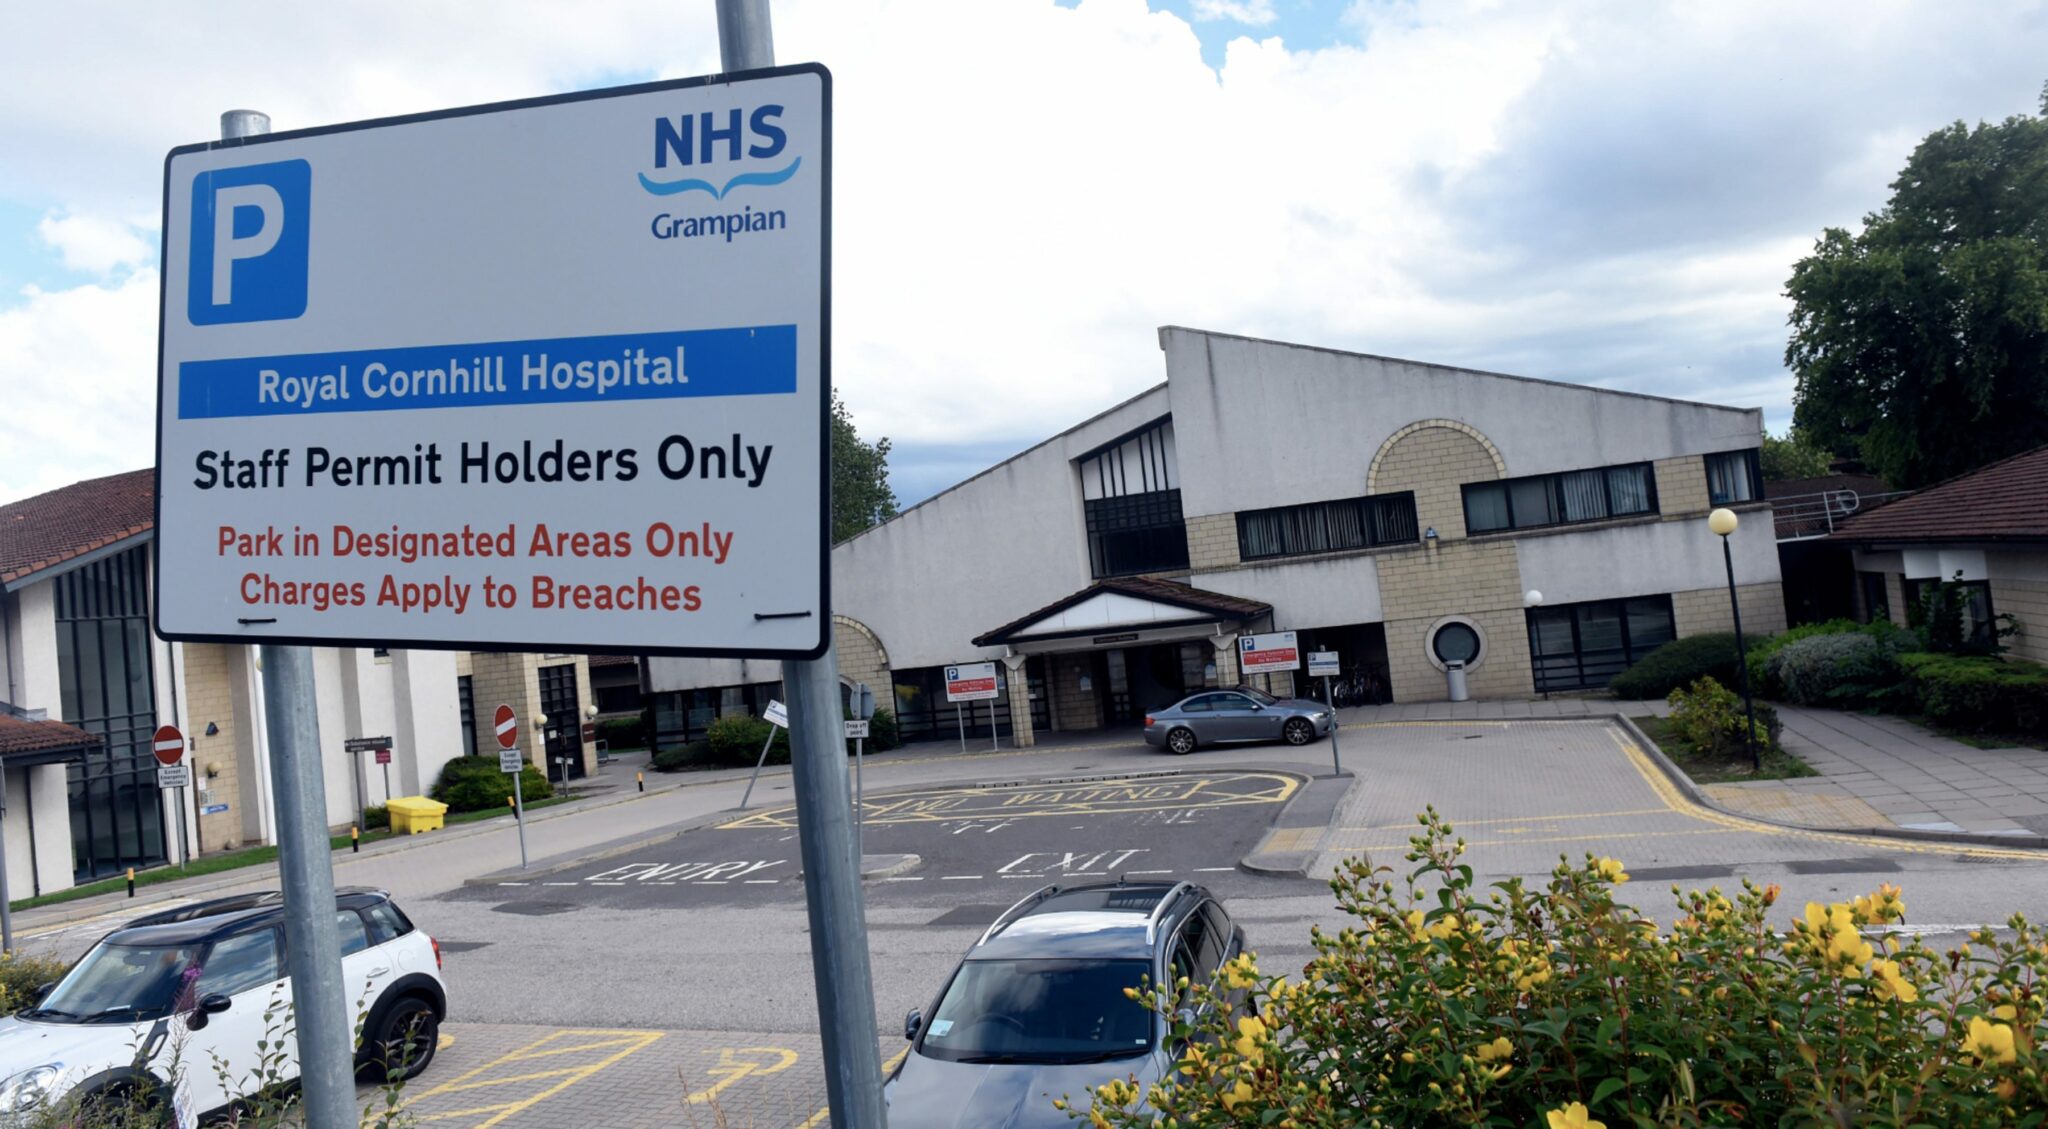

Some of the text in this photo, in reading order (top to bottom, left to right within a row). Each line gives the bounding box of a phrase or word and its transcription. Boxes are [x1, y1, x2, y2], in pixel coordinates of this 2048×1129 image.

[653, 104, 788, 169] NHS
[212, 184, 284, 306] P
[651, 205, 786, 243] Grampian
[259, 346, 689, 408] Royal Cornhill Hospital
[193, 433, 774, 490] Staff Permit Holders Only
[219, 522, 734, 565] Park in Designated Areas Only
[240, 572, 703, 614] Charges Apply to Breaches
[584, 848, 1151, 881] ENTRY EXIT
